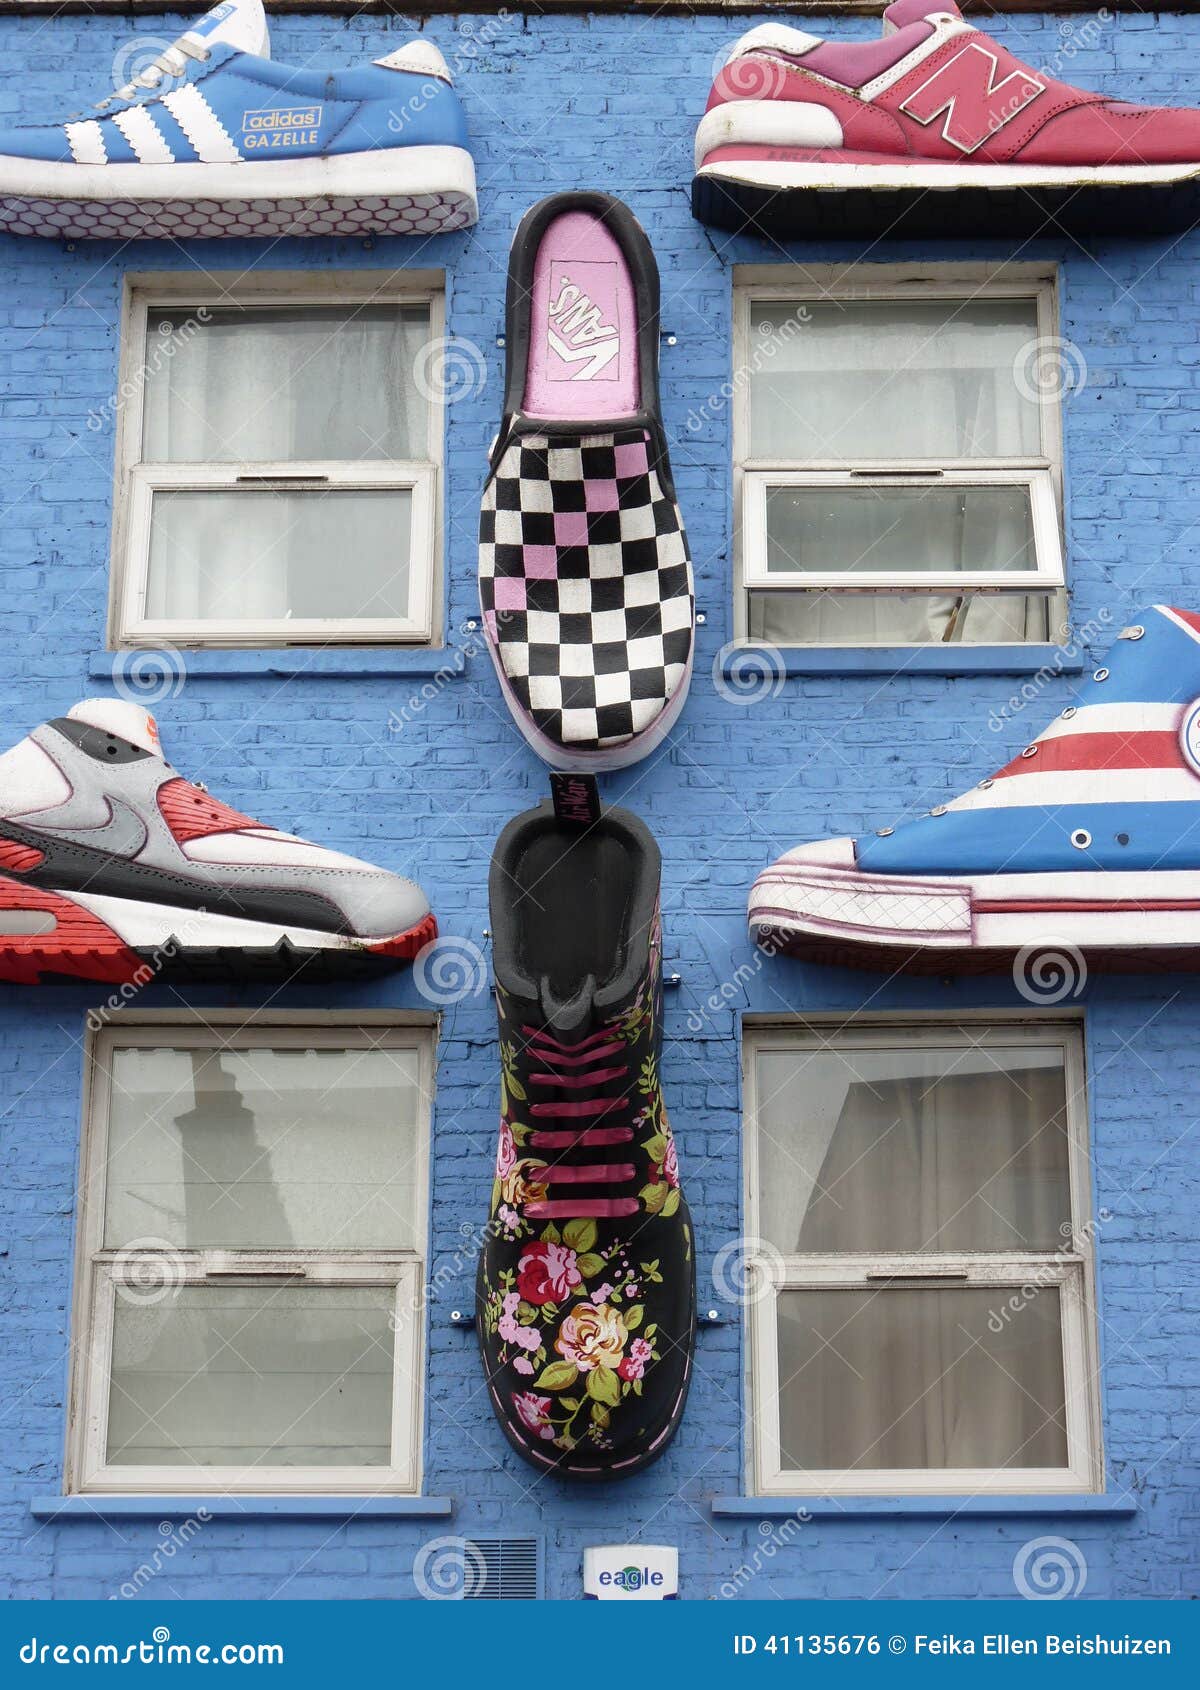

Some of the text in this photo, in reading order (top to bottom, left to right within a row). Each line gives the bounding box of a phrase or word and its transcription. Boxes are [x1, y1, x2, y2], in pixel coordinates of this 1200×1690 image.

[899, 43, 1046, 154] N
[250, 111, 315, 128] adidas
[243, 130, 318, 149] GAZELLE
[547, 284, 619, 380] VANS
[598, 1566, 664, 1591] eagle
